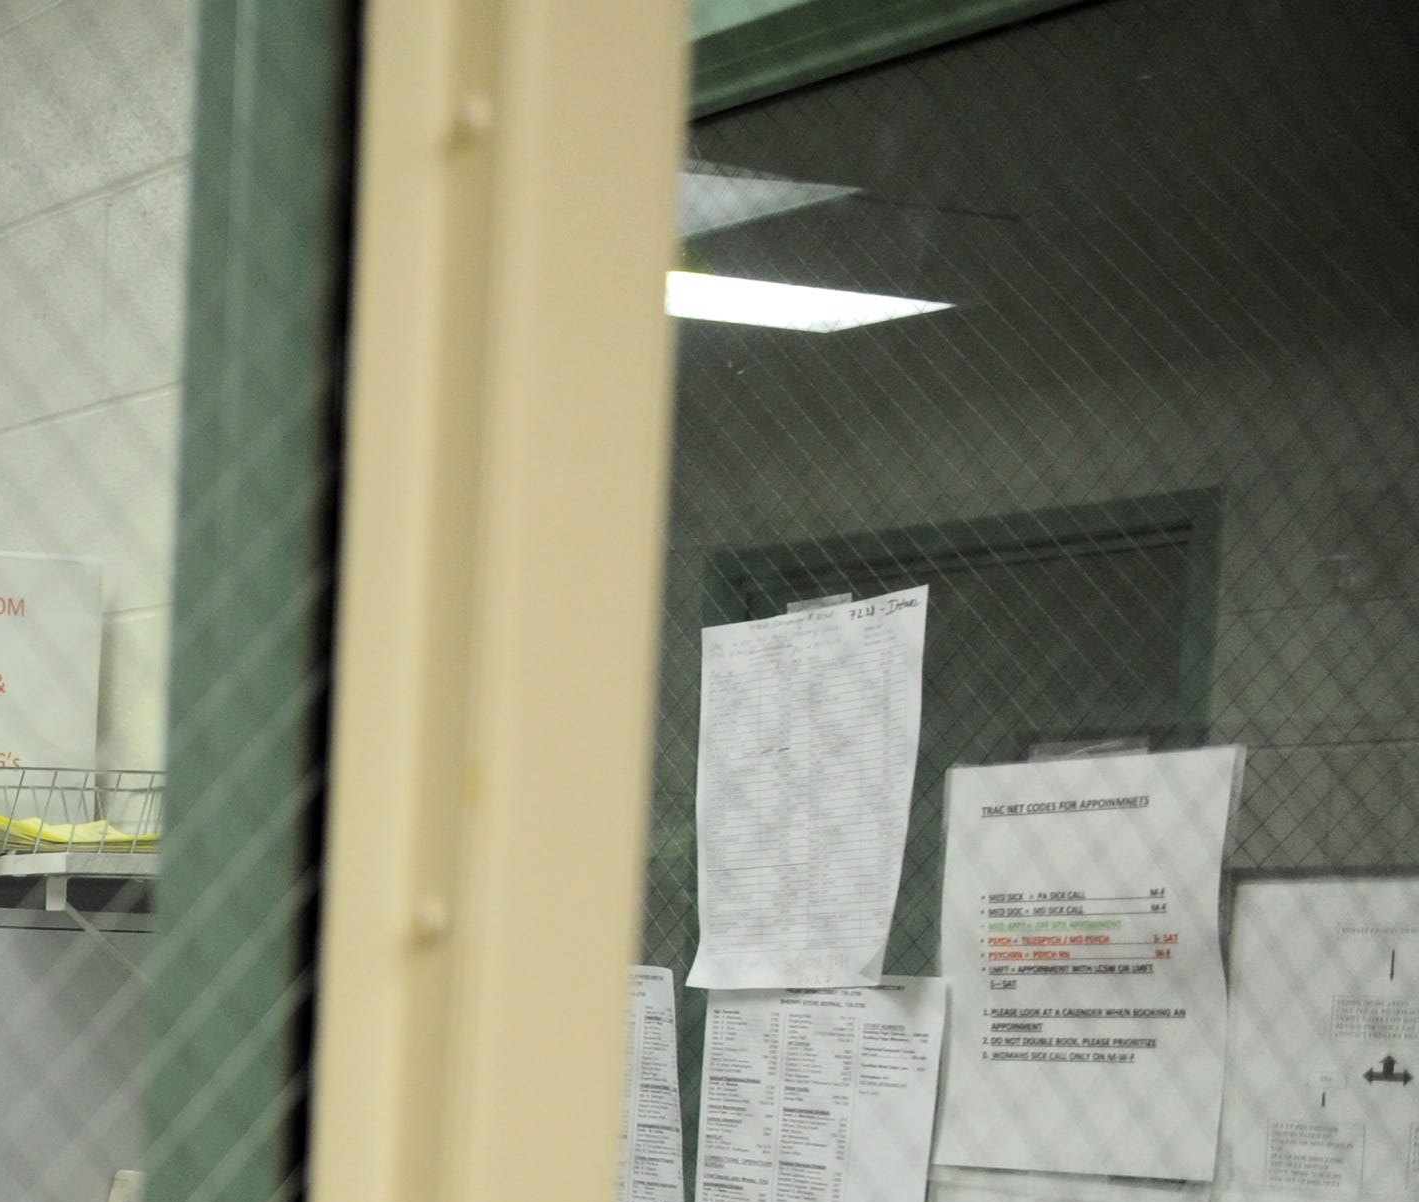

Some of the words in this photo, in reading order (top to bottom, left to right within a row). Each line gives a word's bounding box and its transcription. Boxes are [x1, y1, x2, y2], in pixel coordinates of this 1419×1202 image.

[1006, 804, 1024, 815] NET
[1026, 802, 1056, 813] CODES
[1058, 800, 1077, 812] FOR
[990, 1008, 1017, 1018] PLEASE
[1132, 1008, 1171, 1018] BOOKING
